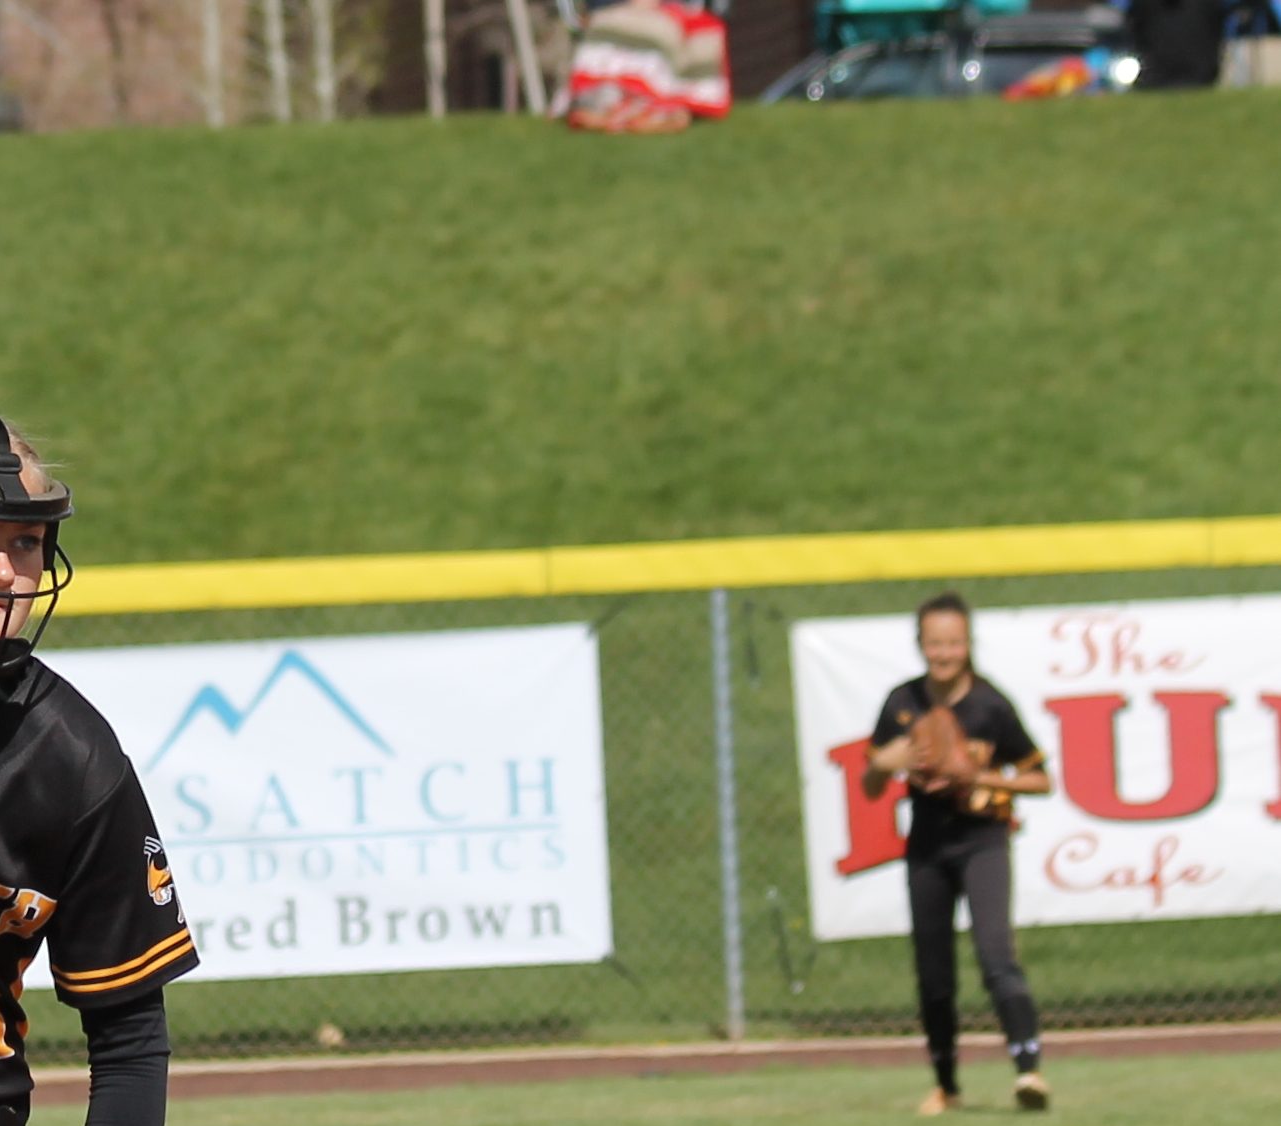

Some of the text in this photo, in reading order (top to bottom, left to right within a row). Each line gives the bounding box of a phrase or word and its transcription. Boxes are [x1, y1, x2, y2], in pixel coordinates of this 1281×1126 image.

[1048, 612, 1210, 679] The
[173, 758, 557, 836] SATCH
[190, 833, 568, 885] ODONTICS
[1044, 830, 1224, 907] Cafe
[334, 894, 565, 949] Brown
